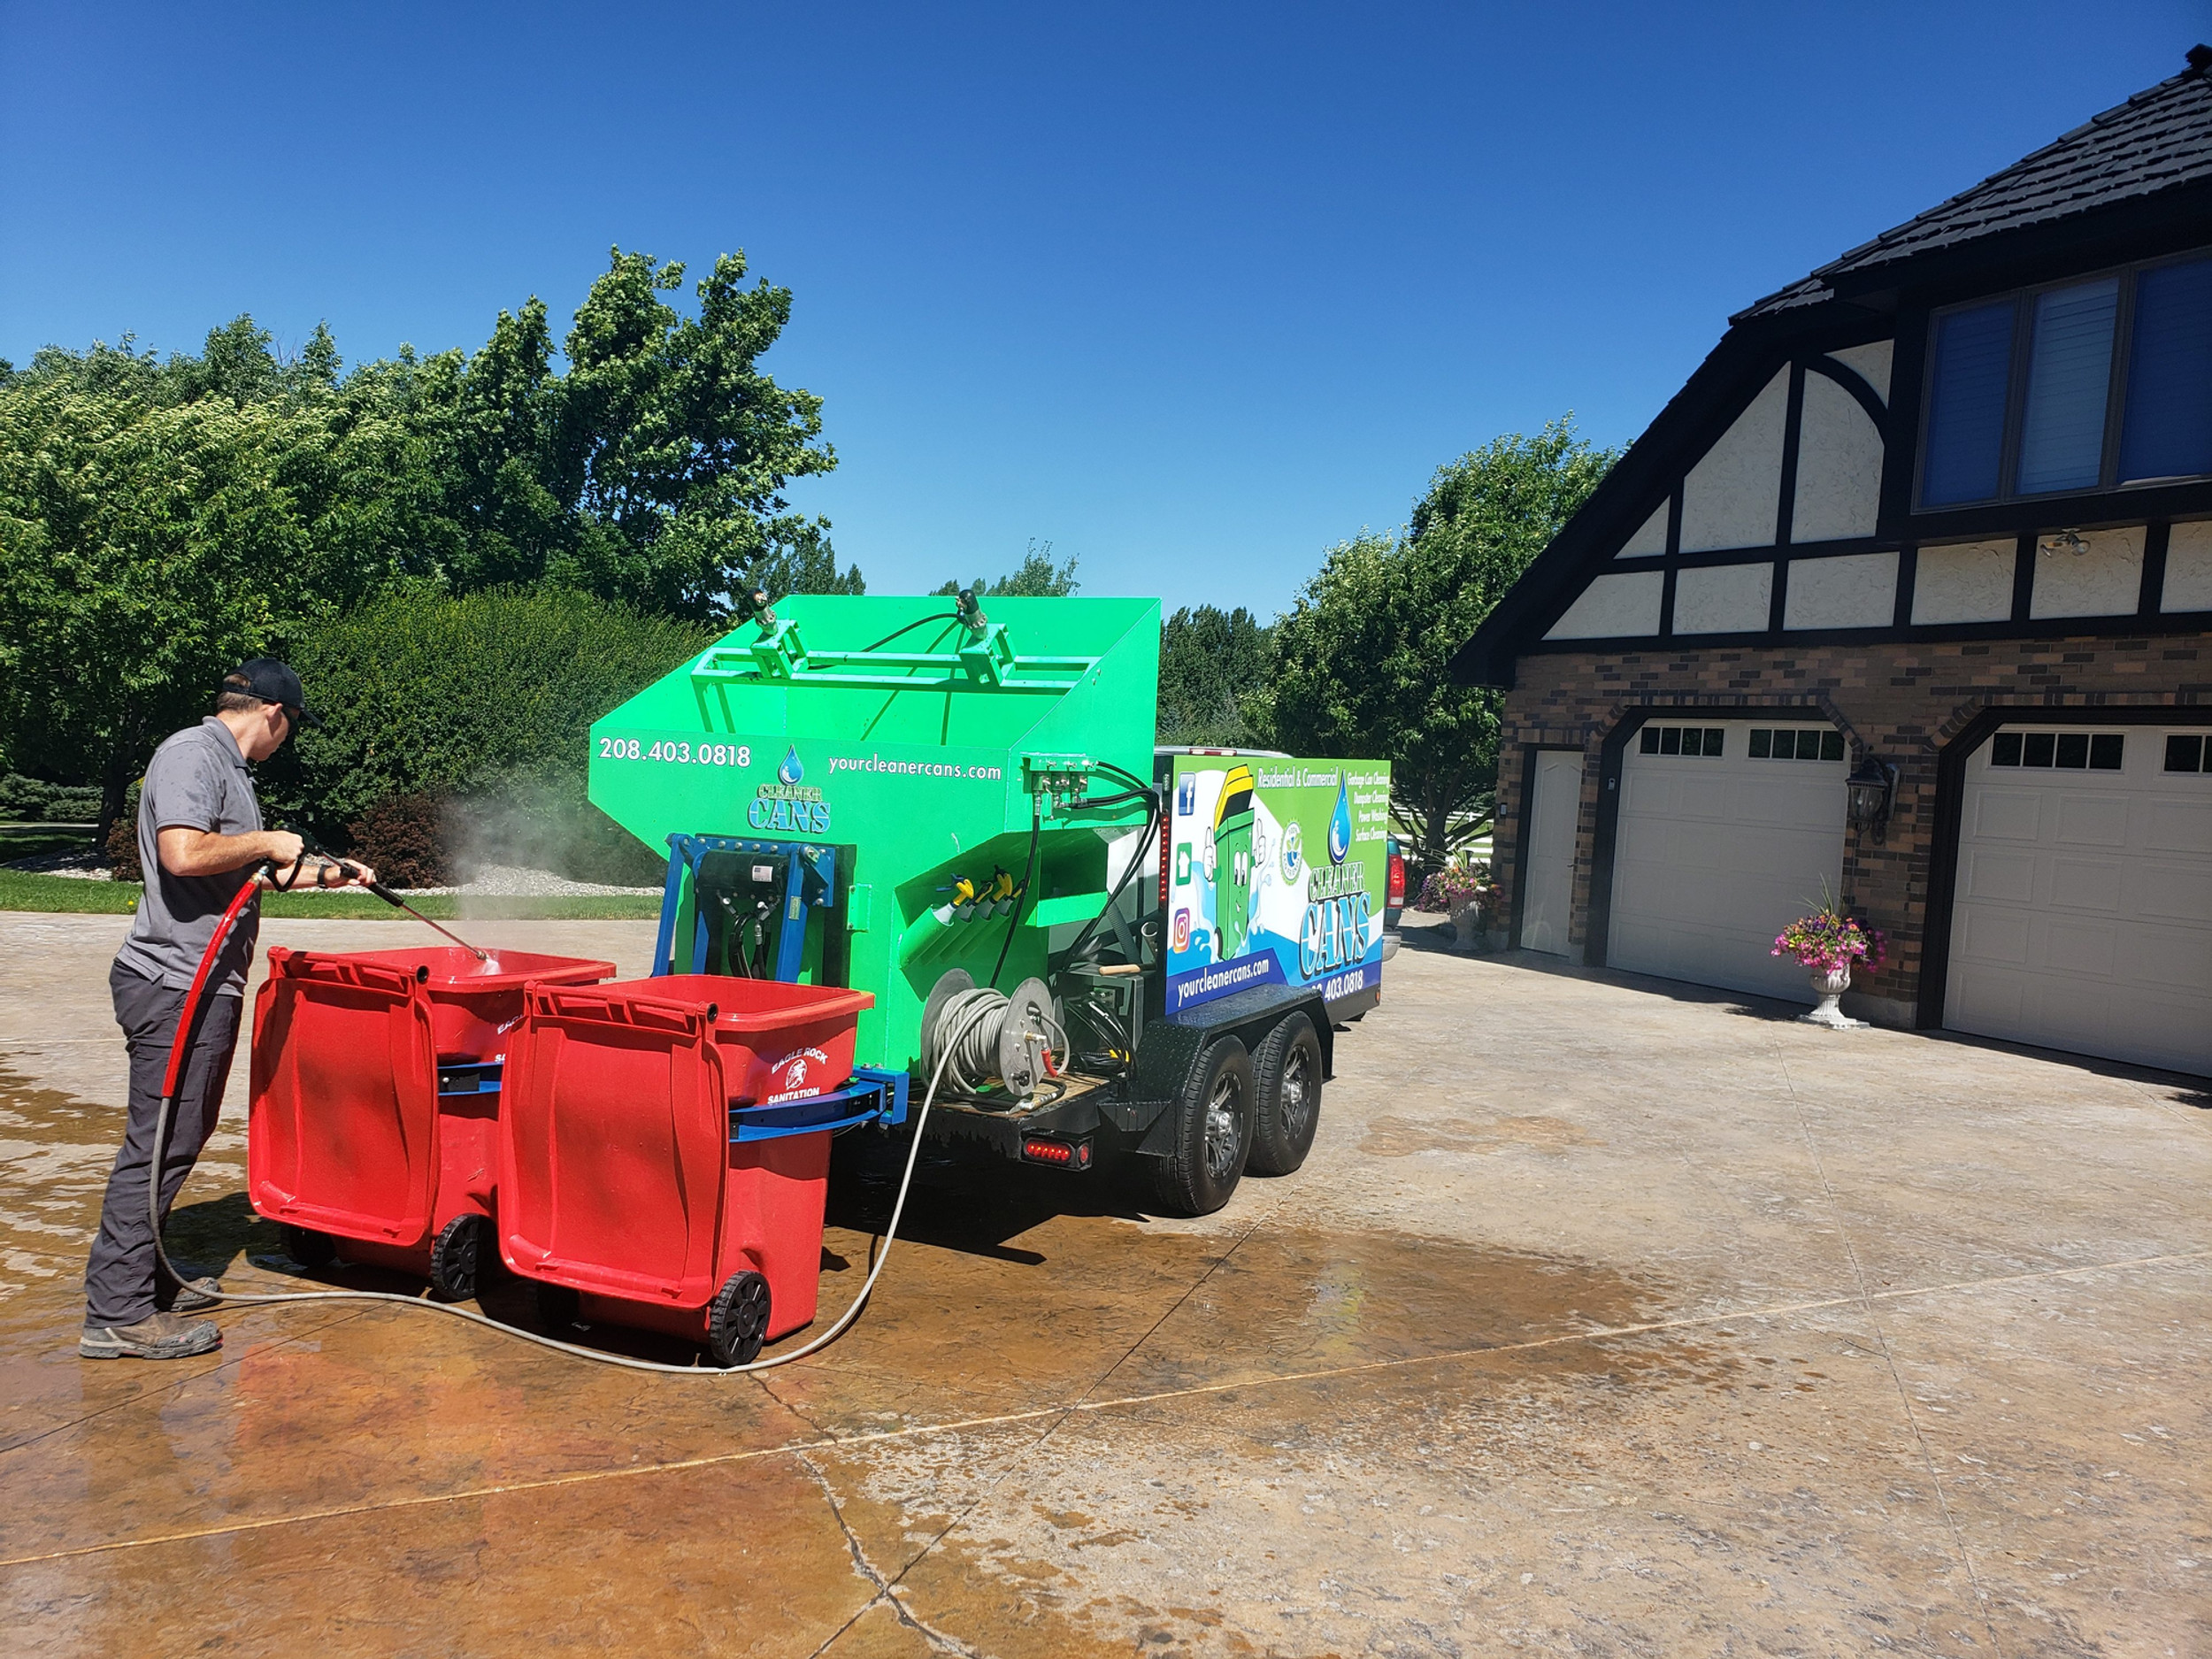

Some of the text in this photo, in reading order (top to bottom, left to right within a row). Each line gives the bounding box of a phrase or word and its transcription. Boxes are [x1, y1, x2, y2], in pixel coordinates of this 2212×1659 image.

[599, 737, 751, 768] 208.403.0818
[828, 752, 1002, 780] yourcleanercans.com
[1257, 765, 1338, 788] Residential & Commercial
[757, 784, 823, 802] CLEANER
[747, 797, 831, 833] CANS
[1309, 861, 1365, 902] CLEANER
[1299, 891, 1371, 980] CANS
[1178, 958, 1270, 1007] yourcleanercans.com
[772, 1047, 828, 1074] EAGLE ROCK
[767, 1087, 820, 1104] SANITATION
